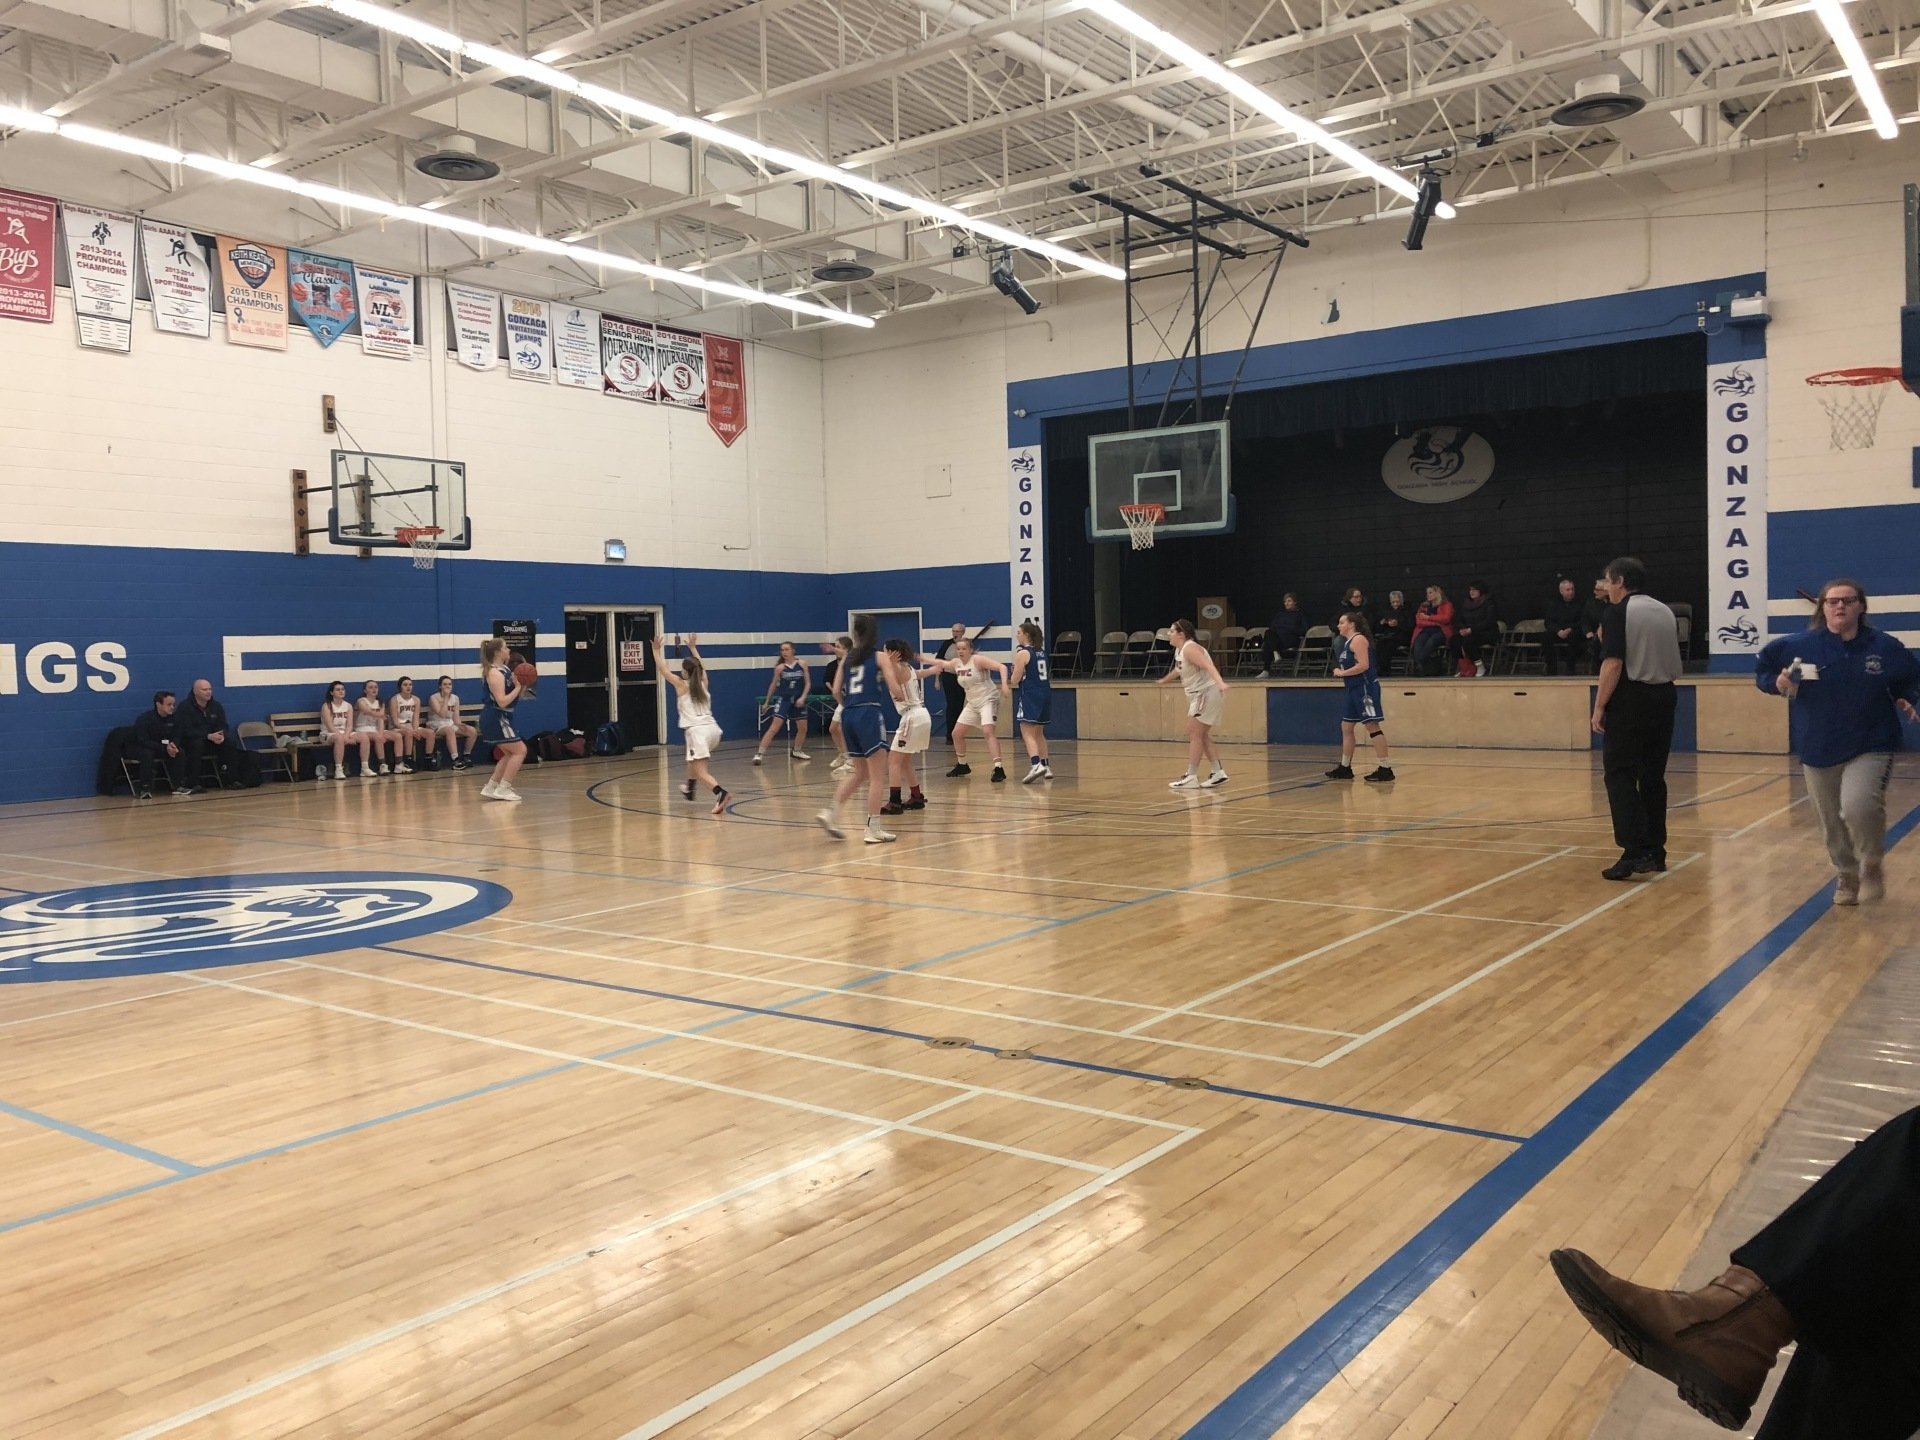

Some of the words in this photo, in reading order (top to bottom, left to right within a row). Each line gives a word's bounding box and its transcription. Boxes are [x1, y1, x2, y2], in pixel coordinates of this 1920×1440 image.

[80, 243, 122, 258] 2013-2014
[0, 247, 39, 275] Bigs
[76, 251, 127, 267] PROVINCIAL
[77, 261, 127, 276] CHAMPIONS
[165, 266, 195, 277] 2013-2014
[154, 278, 206, 293] SPORTSMANSHIP
[172, 274, 189, 283] TEAM
[303, 271, 340, 285] Classic
[0, 295, 47, 308] ROVINCIAL
[230, 286, 250, 296] 2015
[252, 290, 272, 301] TIER
[274, 294, 279, 302] 1
[0, 303, 47, 316] HAMPIONS
[227, 295, 284, 312] CHAMPIONS
[370, 302, 391, 317] NL
[512, 298, 542, 317] 2014
[508, 313, 547, 329] GONZAGA
[508, 323, 548, 337] INVITATIONAL
[602, 320, 624, 331] 2014
[626, 325, 653, 338] ESDNL
[602, 328, 632, 340] SENIOR
[634, 334, 654, 344] HIGH
[365, 333, 412, 345] CHAMPIONS
[461, 333, 490, 344] CHAMPIONS
[515, 332, 542, 348] CHAMPS
[657, 331, 677, 341] 2014
[678, 335, 702, 346] ESDNL
[603, 336, 655, 378] TOURNAMENT
[657, 348, 704, 385] TOURNAMENT
[719, 422, 736, 432] 2014
[1726, 402, 1750, 610] GONZAGA
[503, 625, 528, 633] SPALDING
[1037, 660, 1048, 680] 9
[849, 665, 865, 694] 2
